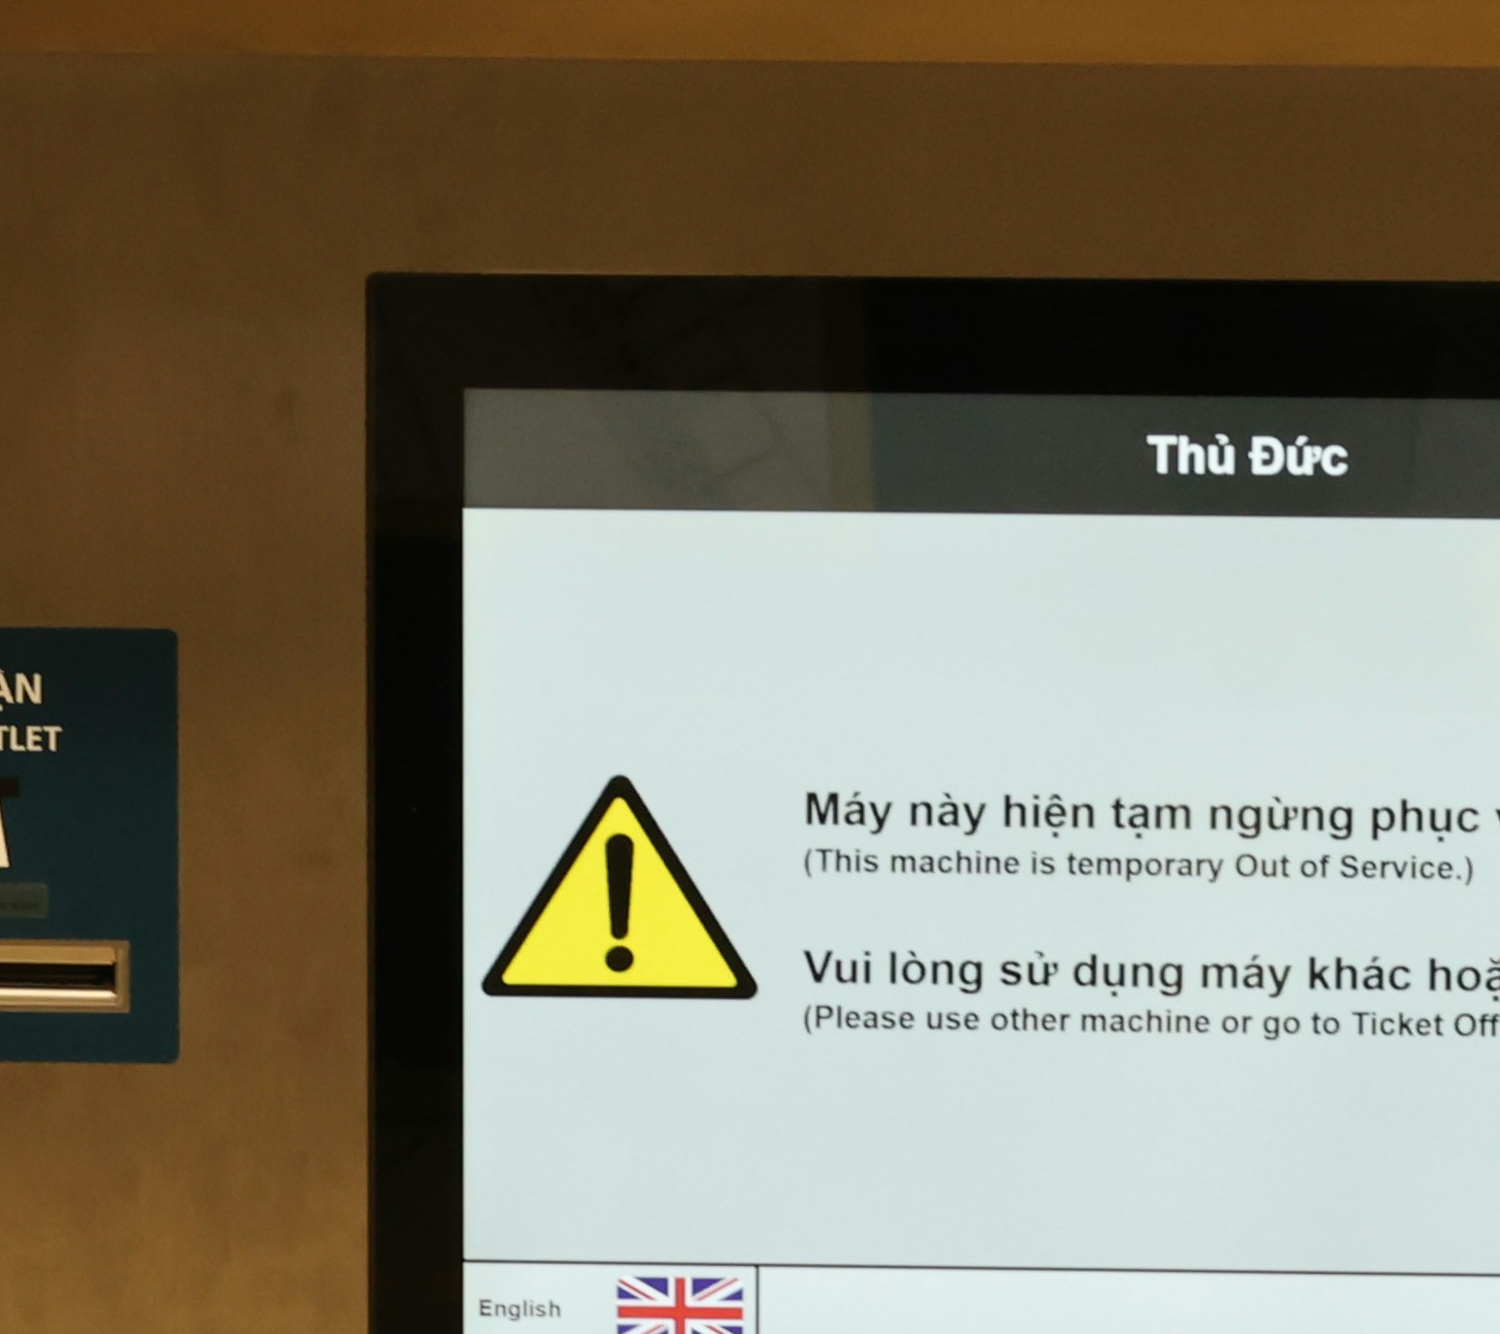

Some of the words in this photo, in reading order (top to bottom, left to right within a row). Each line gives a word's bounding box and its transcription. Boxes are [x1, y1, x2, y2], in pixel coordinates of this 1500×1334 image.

[1146, 434, 1235, 475] Thủ
[1248, 435, 1348, 476] Đức
[806, 791, 892, 835] Máy
[910, 792, 986, 836] này
[1004, 794, 1094, 838] hiện
[1111, 798, 1191, 839] tạm
[1210, 796, 1353, 840] ngừng
[1371, 799, 1479, 842] phục
[804, 848, 879, 877] (This
[891, 850, 1020, 875] machine
[1032, 851, 1056, 875] is
[1067, 853, 1224, 883] temporary
[1235, 853, 1290, 878] Out
[1300, 854, 1330, 878] of
[1340, 854, 1473, 886] Service.)
[803, 950, 871, 985] Vui
[890, 950, 983, 993] lòng
[1000, 951, 1058, 985] sử
[1073, 954, 1183, 995] dụng
[1202, 955, 1291, 998] máy
[1309, 956, 1411, 992] khác
[804, 1005, 915, 1034] (Please
[927, 1011, 980, 1031] use
[991, 1007, 1071, 1032] other
[1081, 1009, 1210, 1033] machine
[1221, 1015, 1253, 1034] or
[1263, 1016, 1301, 1041] go
[1311, 1012, 1340, 1035] to
[1352, 1011, 1444, 1037] Ticket
[479, 1299, 561, 1322] English
